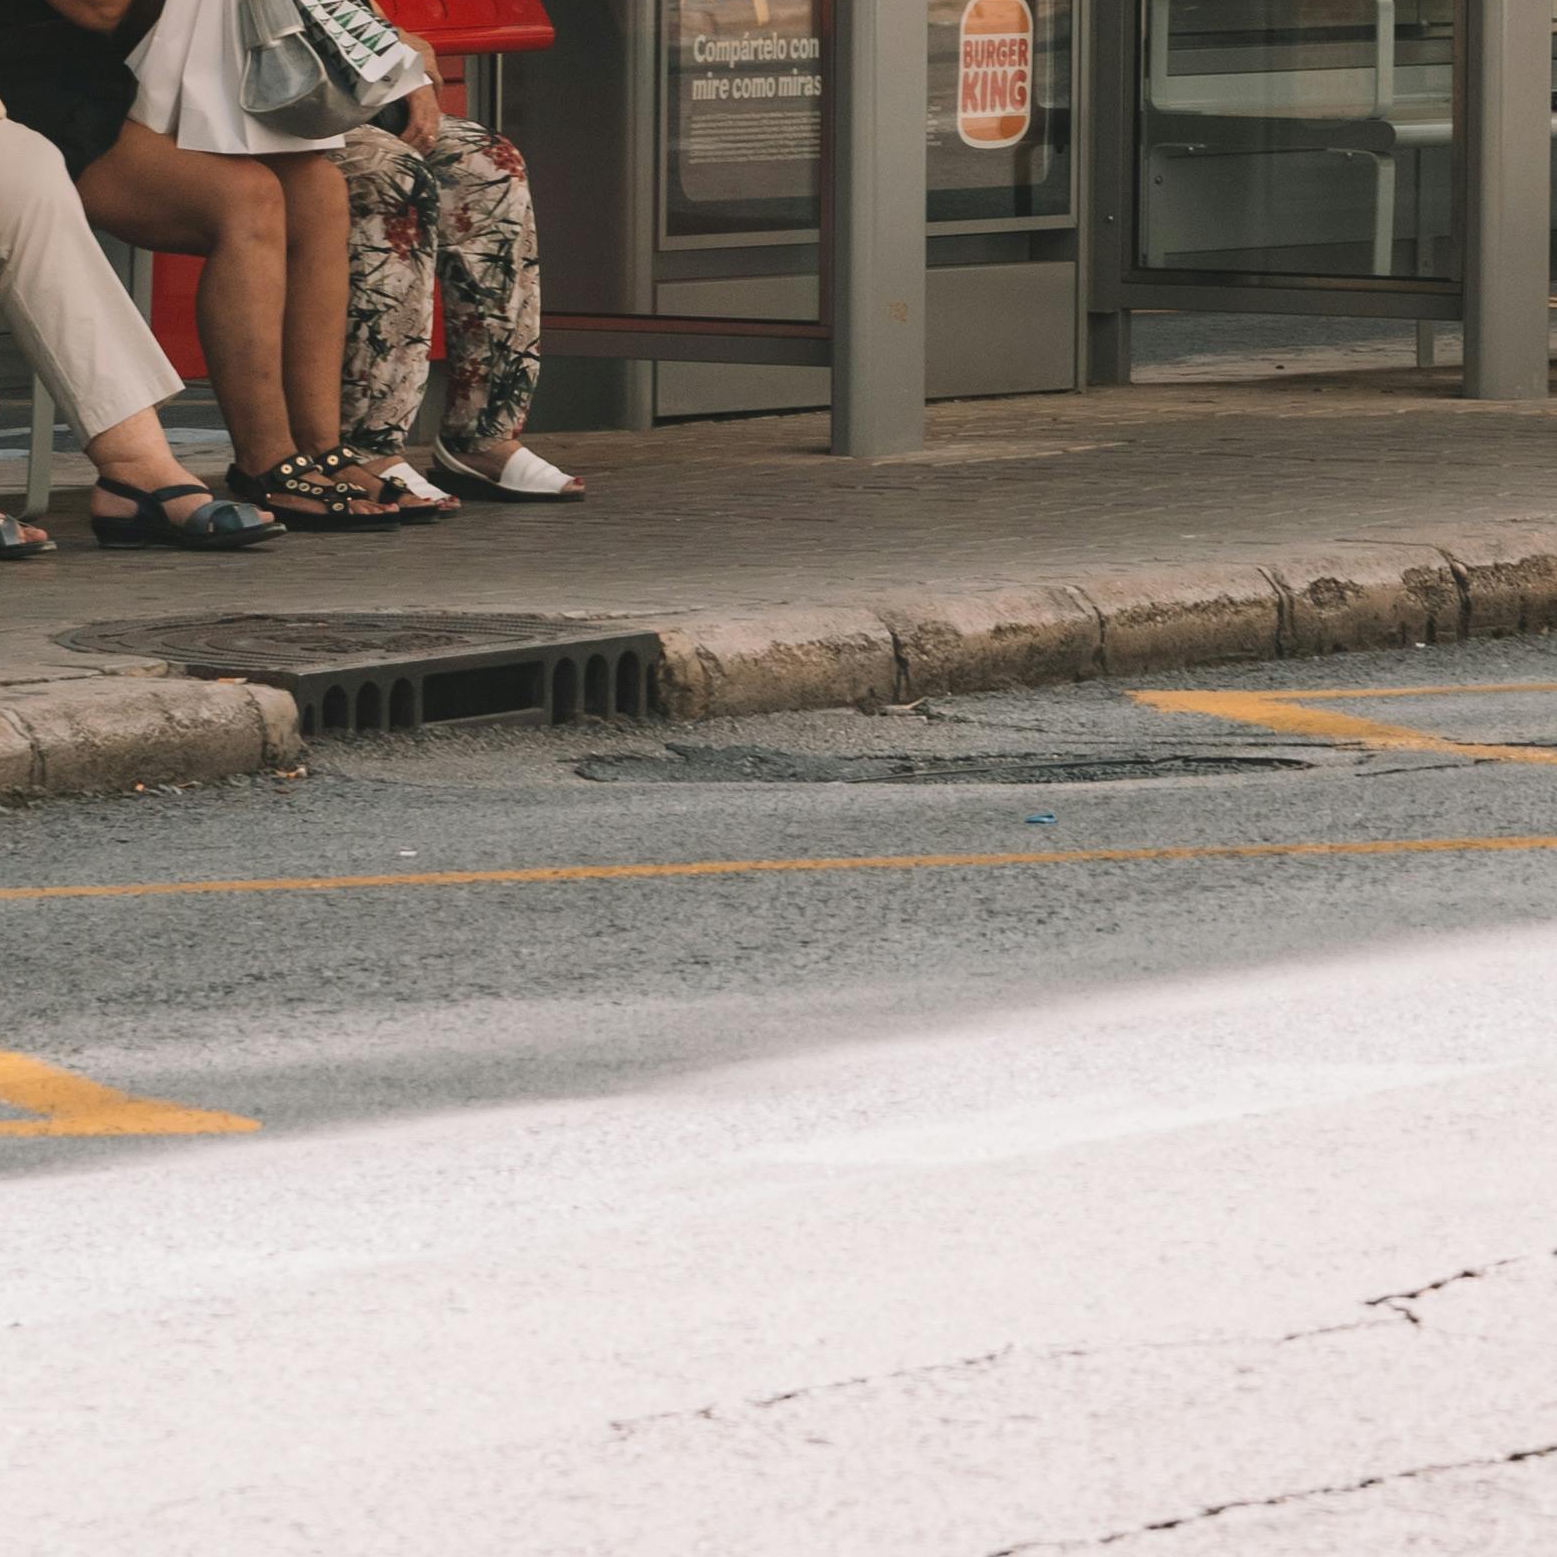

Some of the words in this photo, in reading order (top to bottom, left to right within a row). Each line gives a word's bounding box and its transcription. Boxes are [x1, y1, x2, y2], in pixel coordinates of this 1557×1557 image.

[693, 31, 787, 68] Compártelo
[790, 37, 820, 59] con
[963, 38, 1028, 69] BURGER
[692, 72, 729, 100] mire
[731, 76, 776, 99] como
[778, 68, 822, 97] miras
[962, 69, 1027, 113] KING
